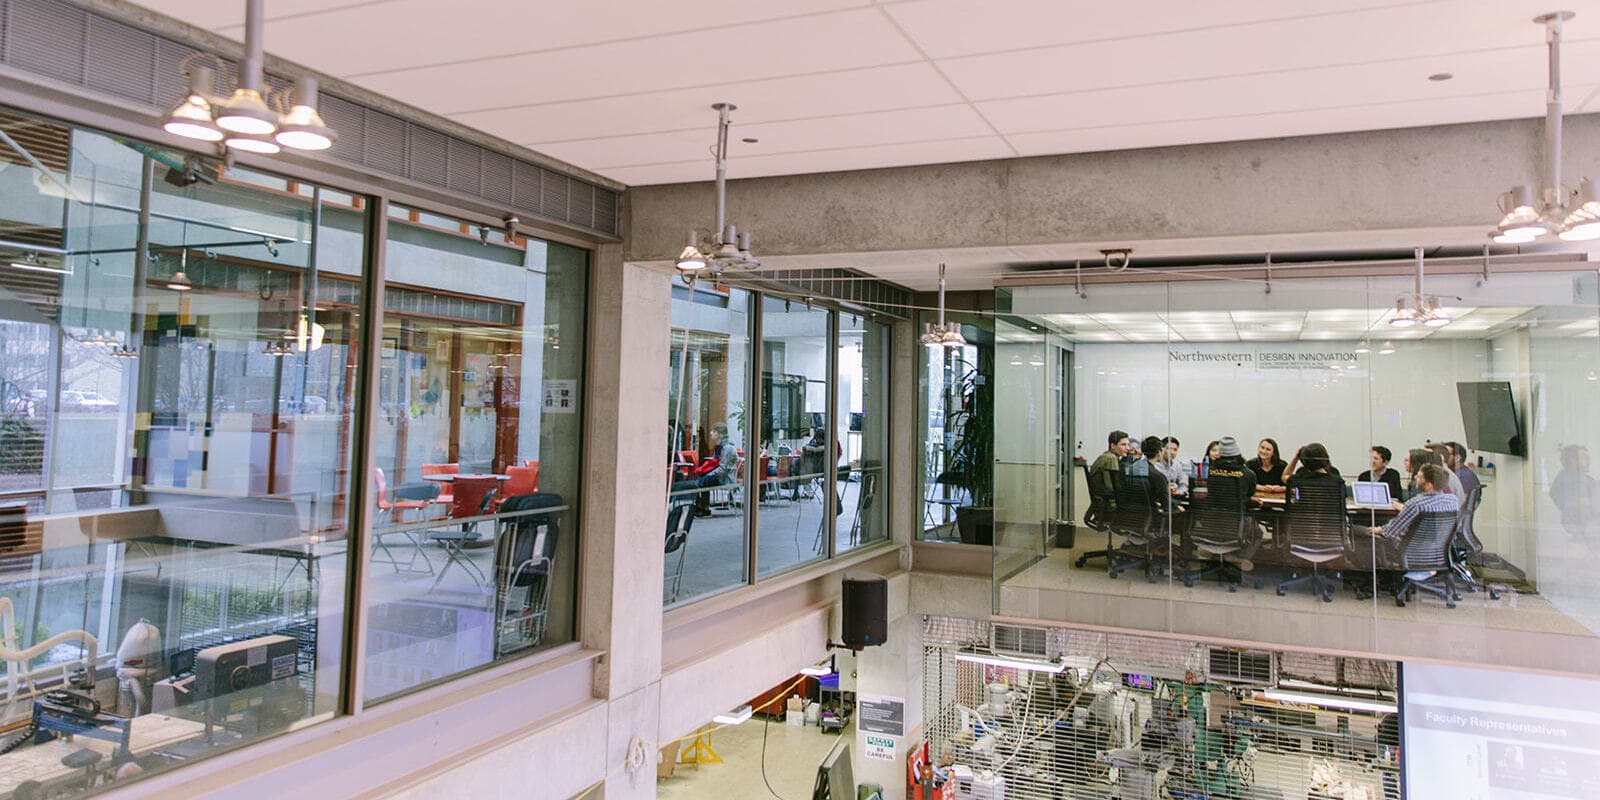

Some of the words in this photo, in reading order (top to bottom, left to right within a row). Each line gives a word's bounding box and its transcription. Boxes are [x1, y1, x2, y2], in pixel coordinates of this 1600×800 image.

[1169, 351, 1252, 361] Northwestern
[1260, 352, 1295, 361] DESIGN
[1299, 352, 1358, 361] INNOVATION
[1425, 711, 1468, 727] Faculty
[1470, 716, 1568, 737] Representatives
